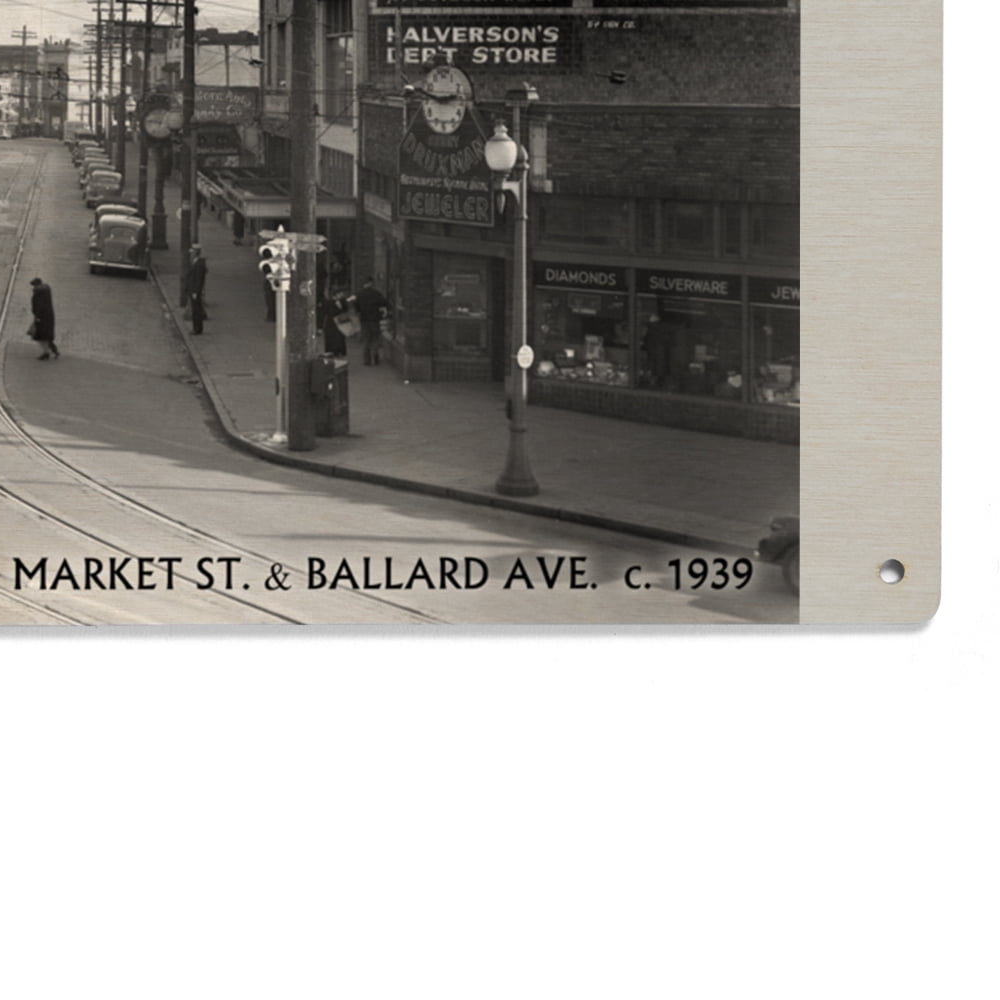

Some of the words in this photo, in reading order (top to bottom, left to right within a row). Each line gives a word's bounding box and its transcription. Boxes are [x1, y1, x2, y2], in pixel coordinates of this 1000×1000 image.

[386, 26, 560, 43] HALVERSON'S
[471, 46, 558, 63] STORE
[400, 191, 490, 221] JEWELER
[545, 267, 617, 286] DIAMONDS
[649, 275, 729, 296] SILVERWARE
